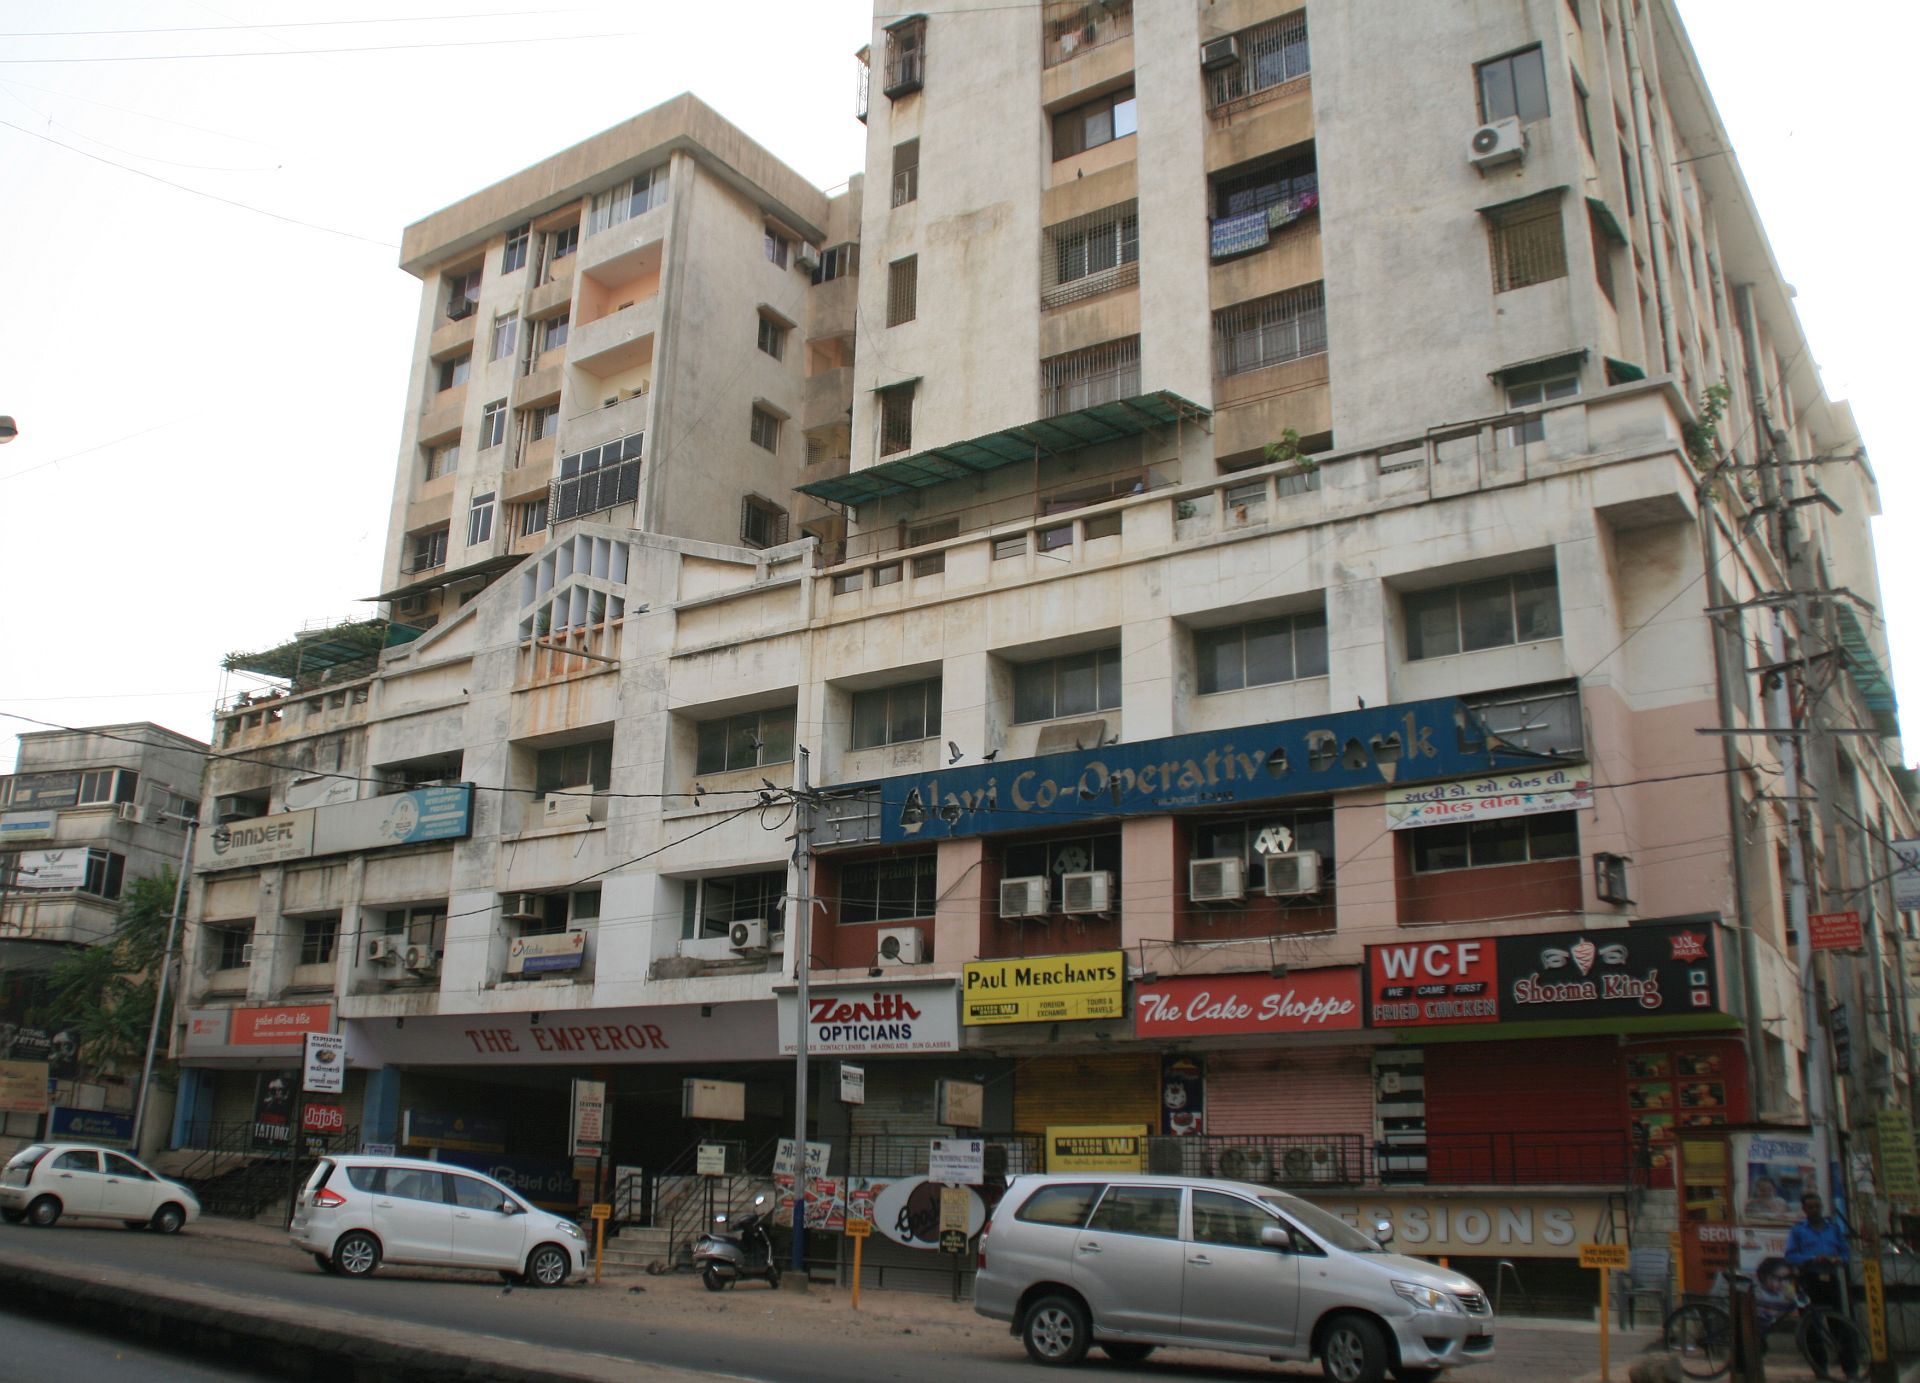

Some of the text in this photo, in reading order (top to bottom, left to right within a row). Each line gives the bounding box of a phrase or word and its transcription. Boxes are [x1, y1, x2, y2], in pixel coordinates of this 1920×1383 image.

[1382, 943, 1481, 979] WCF
[1388, 984, 1483, 996] WE CAME FIRST
[1514, 969, 1662, 1008] Shorma King
[809, 992, 921, 1024] Zenith
[1040, 1001, 1065, 1009] FOREIGN
[1087, 998, 1107, 1006] TOURS
[1087, 1006, 1113, 1014] TRAVELS
[1139, 990, 1355, 1024] The Cake Shoppe
[1374, 999, 1496, 1020] FRIED CHICKEN
[1037, 1009, 1067, 1018] EXCHANGE
[465, 1024, 669, 1052] THE EMPEROR
[820, 1024, 912, 1041] OPTICIANS
[305, 1108, 342, 1128] Jojo's
[255, 1123, 290, 1140] TATTOOZ
[1057, 1139, 1103, 1147] WESTERN
[1583, 1256, 1627, 1266] PARKING
[1584, 1248, 1626, 1257] MEMBER
